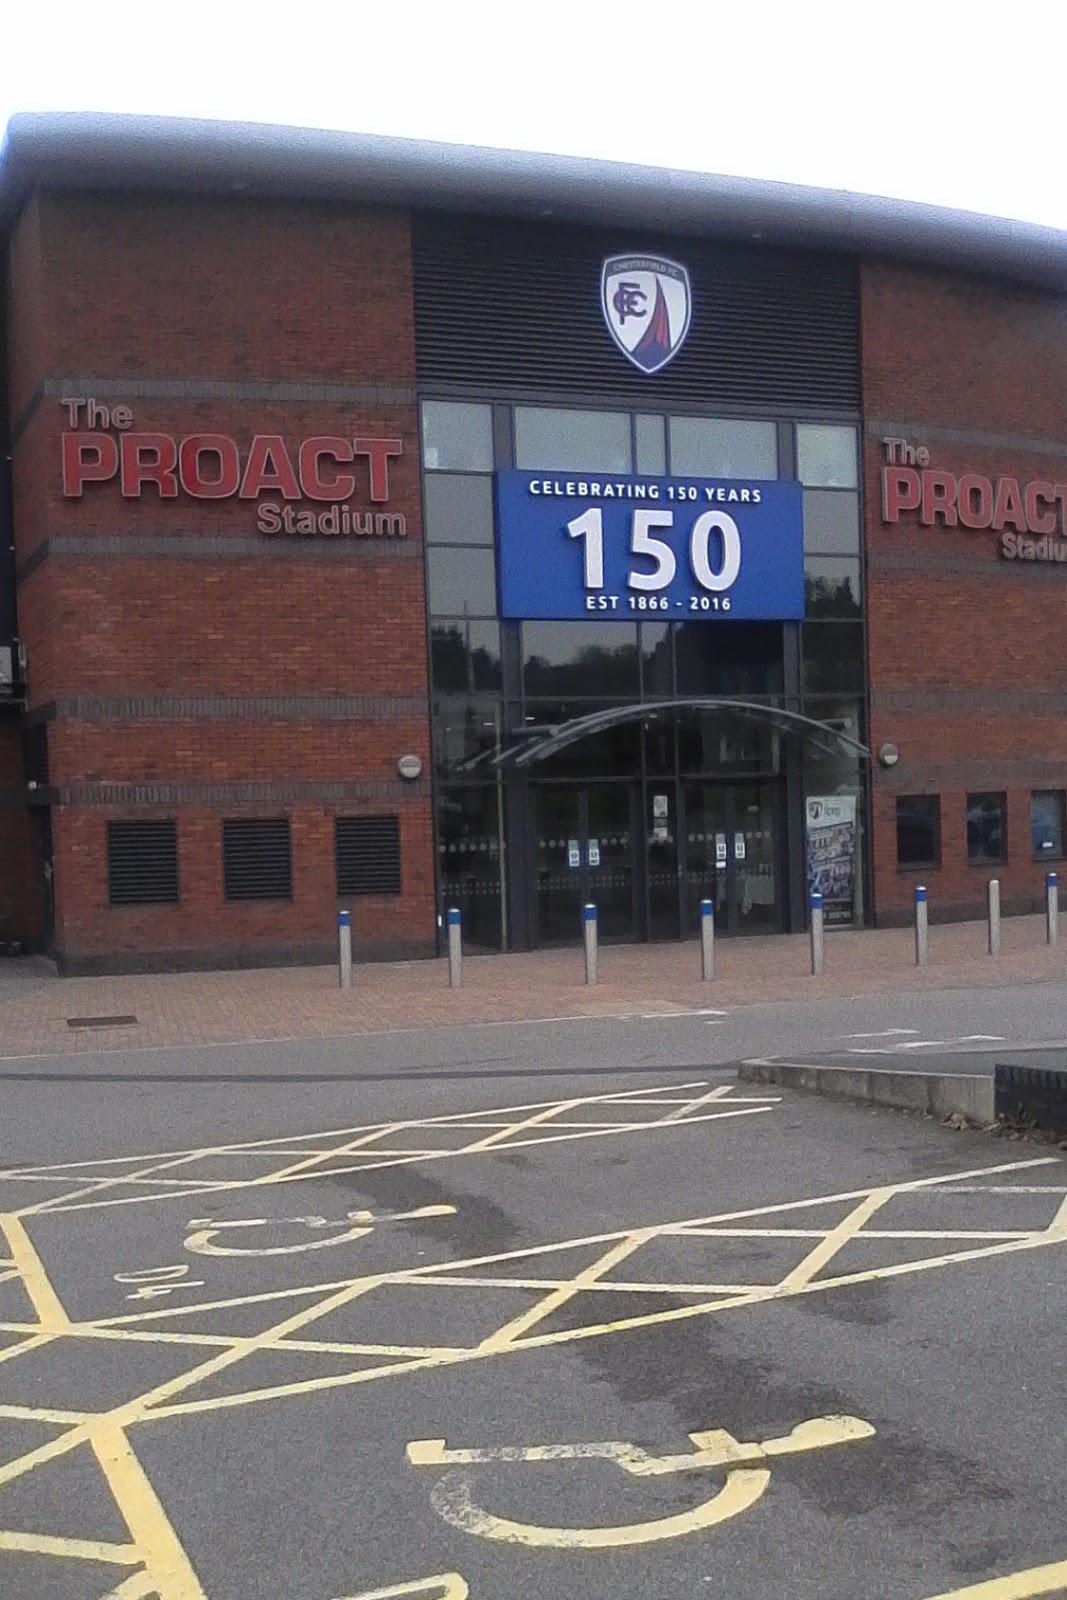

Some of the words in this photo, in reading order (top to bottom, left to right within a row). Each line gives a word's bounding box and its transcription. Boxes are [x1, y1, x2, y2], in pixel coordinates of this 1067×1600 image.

[61, 397, 133, 430] The
[61, 432, 403, 502] PROACT
[883, 436, 931, 467] The
[529, 479, 660, 500] CELEBRATING
[666, 486, 698, 501] 150
[705, 487, 763, 503] YEARS
[256, 502, 407, 536] Stadium
[566, 507, 741, 592] 150
[1002, 532, 1067, 562] Stadiu
[585, 596, 619, 610] EST
[628, 596, 669, 611] 1866
[690, 596, 732, 611] 2016
